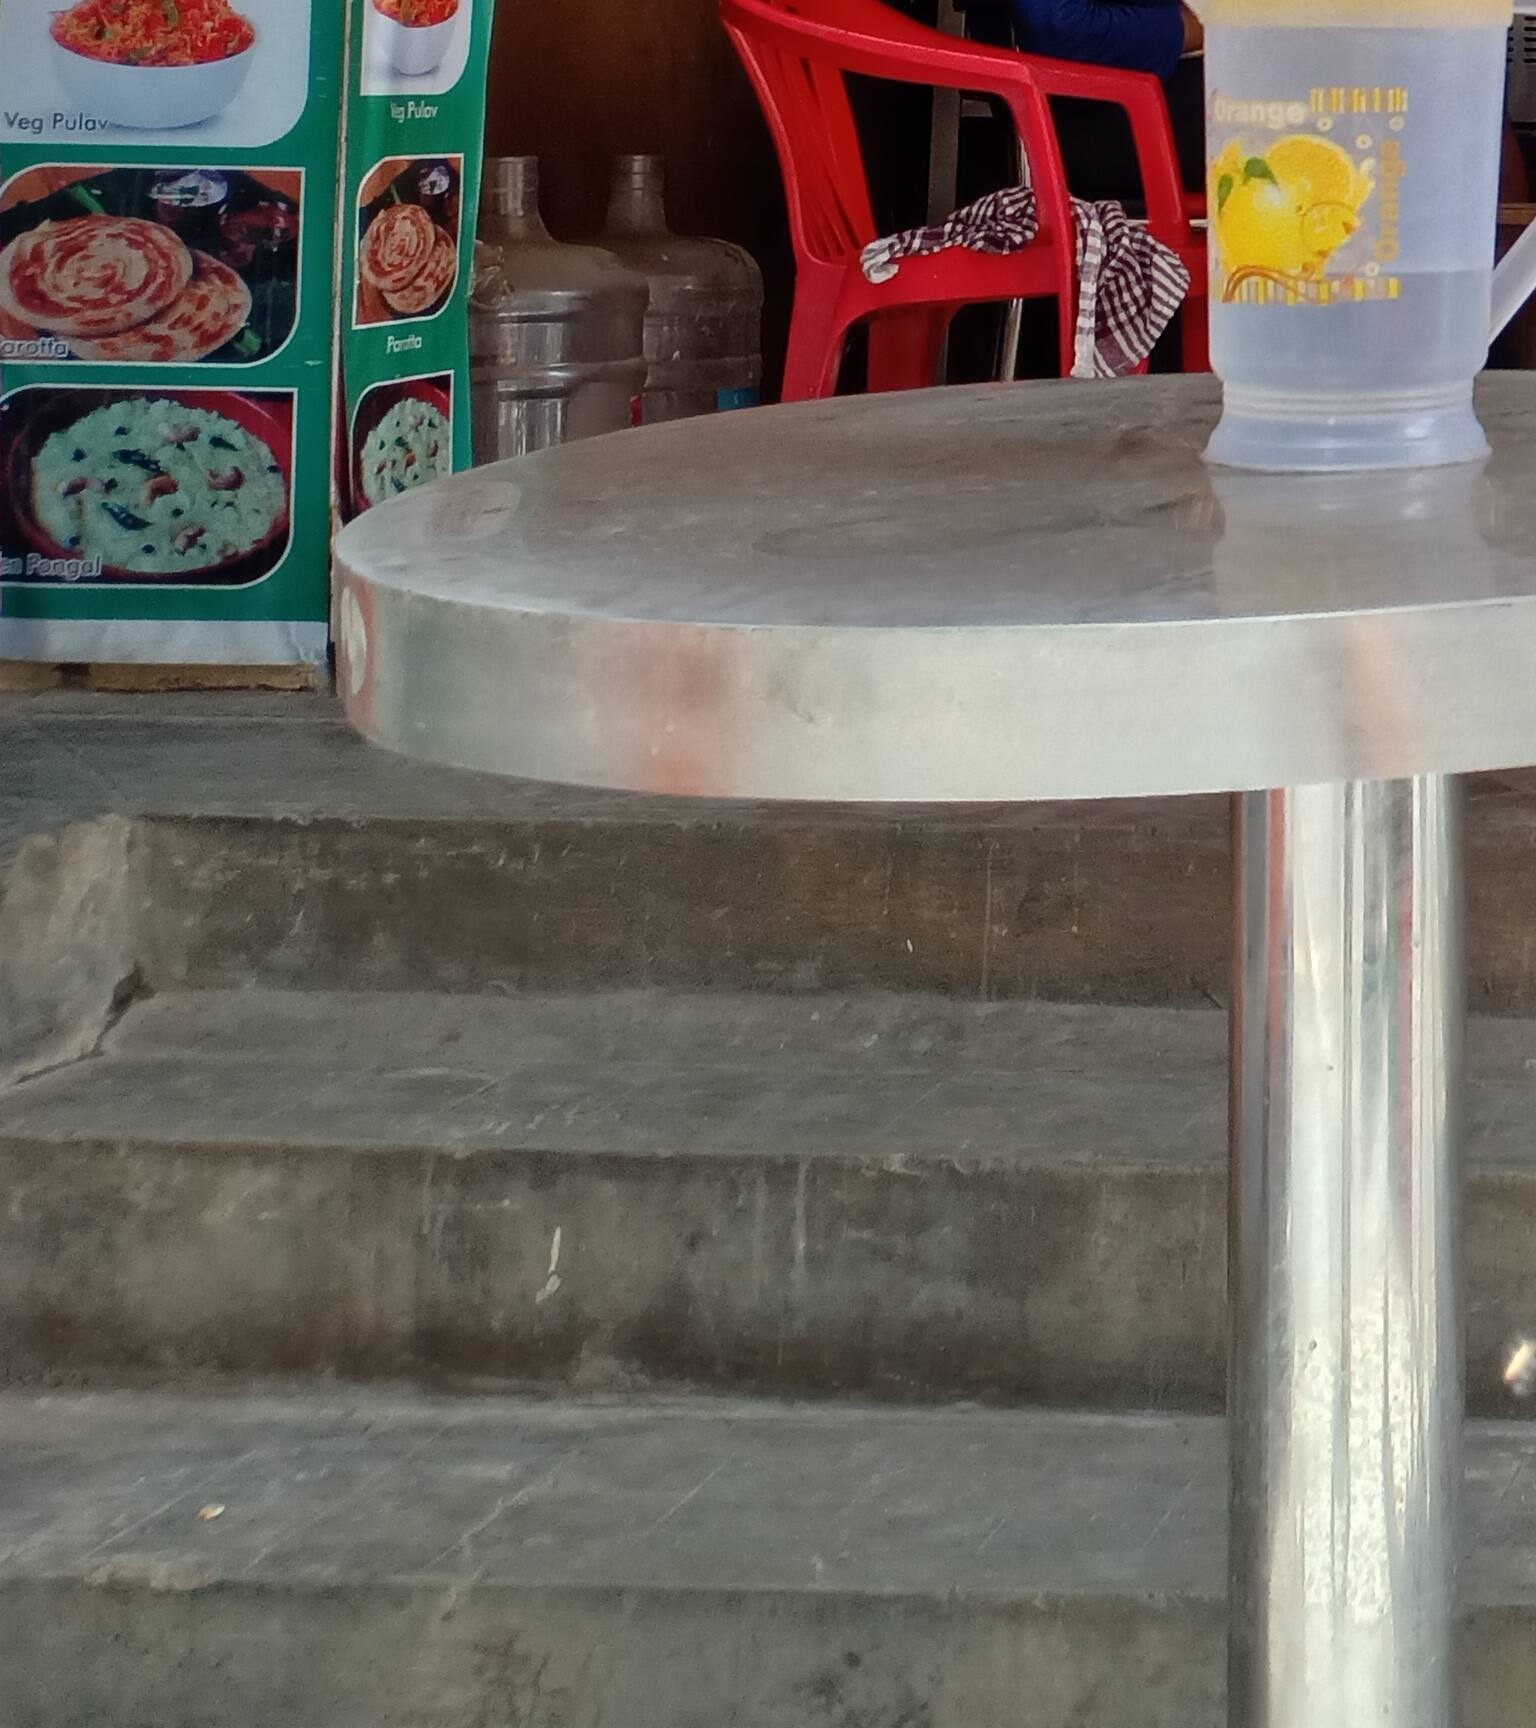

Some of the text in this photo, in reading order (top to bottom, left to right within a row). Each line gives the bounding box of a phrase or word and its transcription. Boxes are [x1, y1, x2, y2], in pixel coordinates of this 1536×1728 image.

[4, 111, 108, 135] Veg Pulav
[1213, 94, 1307, 130] Orange
[0, 336, 70, 358] arotta
[26, 552, 103, 582] Pongal
